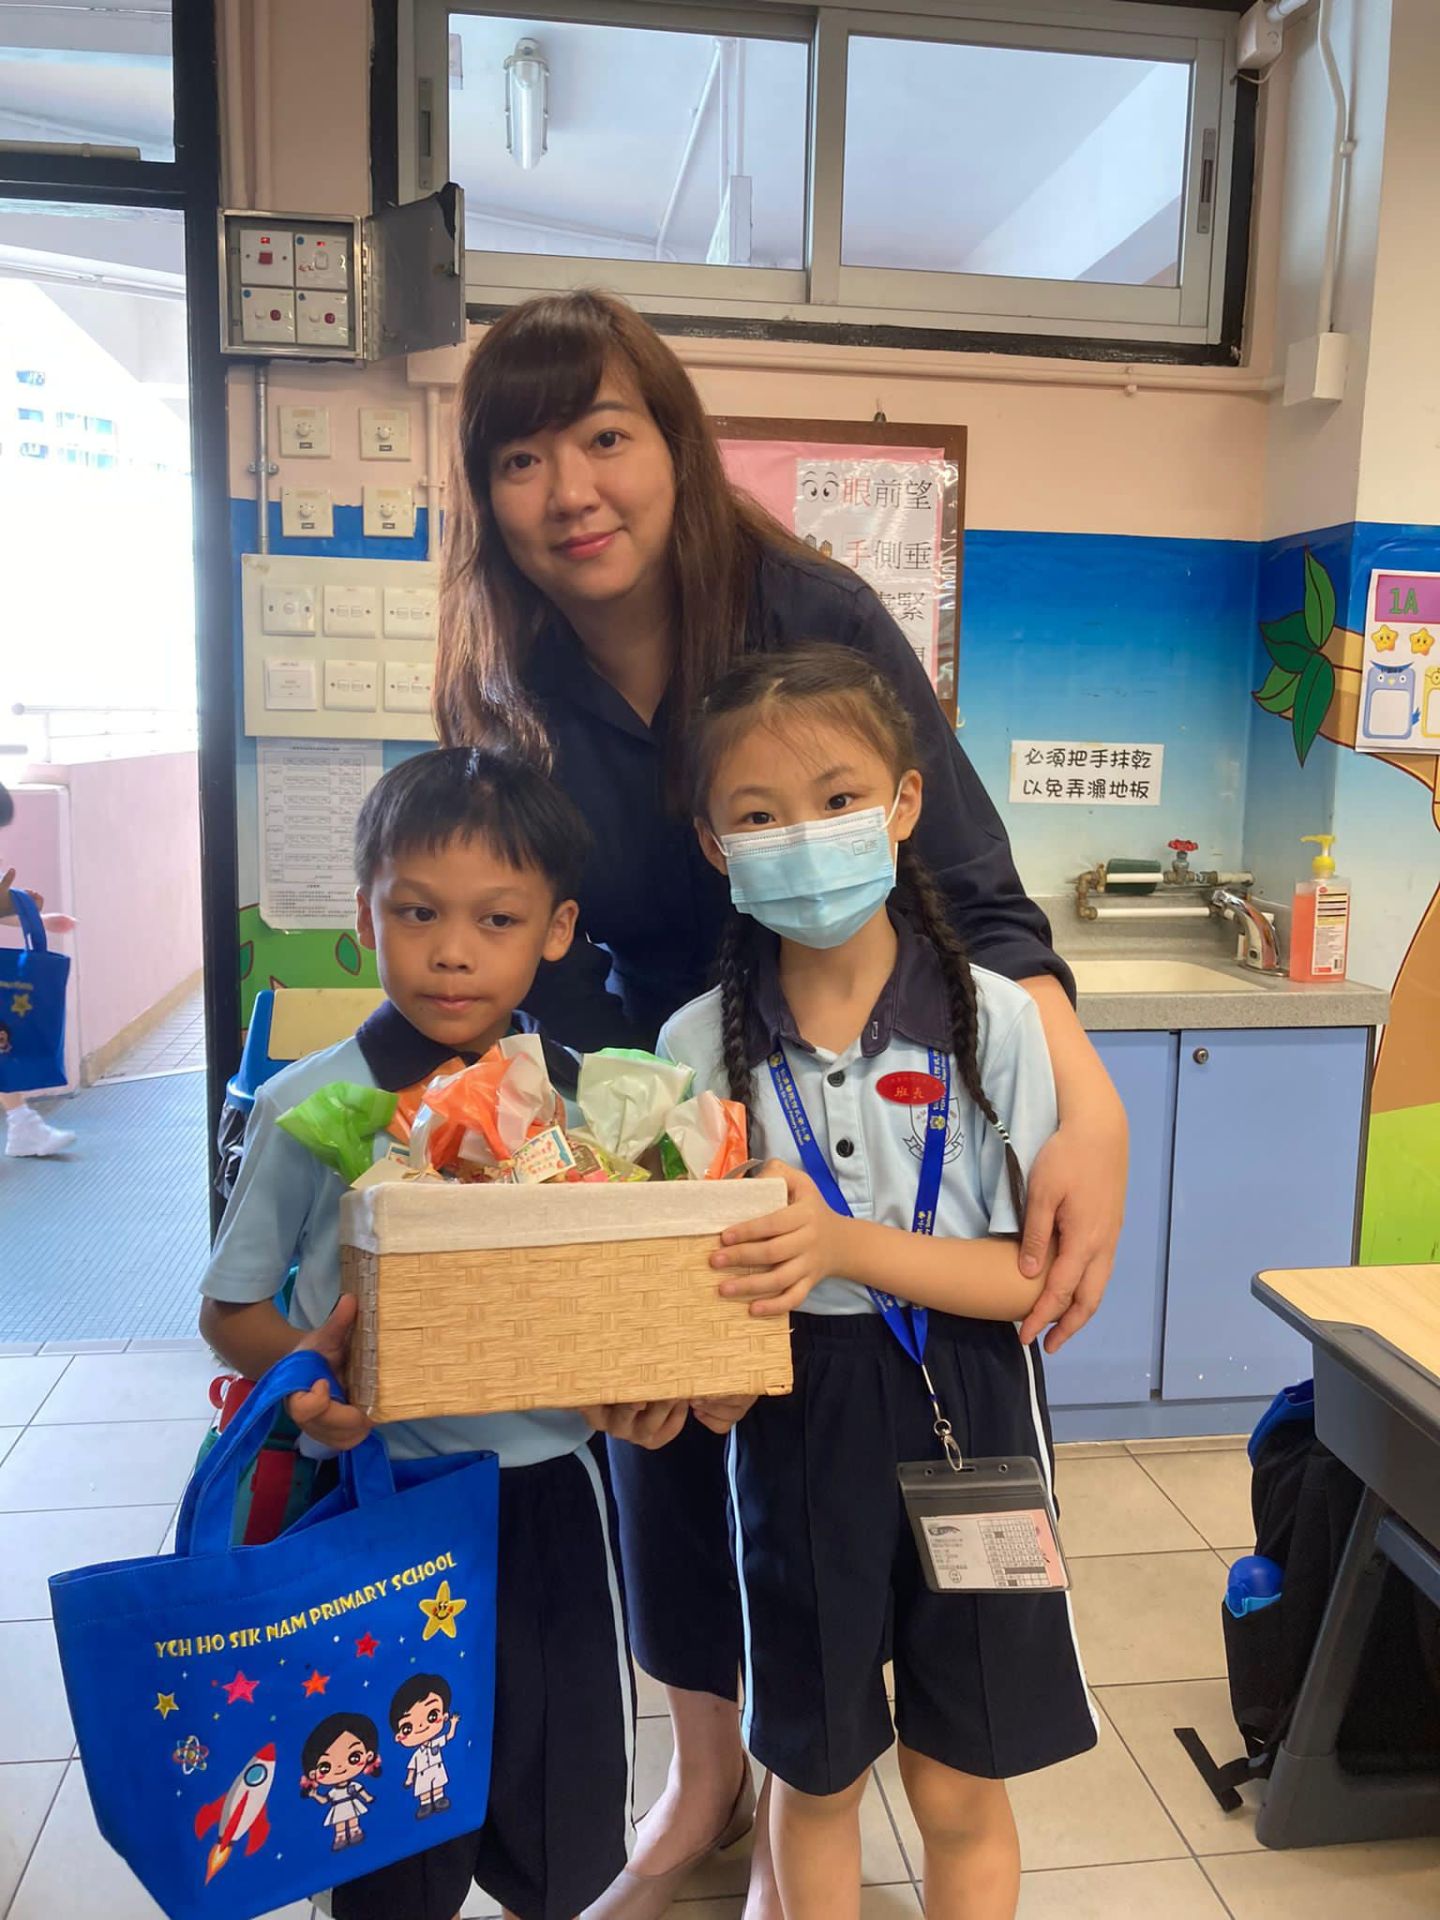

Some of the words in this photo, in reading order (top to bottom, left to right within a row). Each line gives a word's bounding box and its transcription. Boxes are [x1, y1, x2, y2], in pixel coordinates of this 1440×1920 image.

[842, 477, 932, 510] 眼前望
[845, 539, 931, 570] 手側垂
[1389, 587, 1419, 615] 1A
[154, 1638, 191, 1658] YCH
[197, 1634, 225, 1655] HO
[229, 1628, 261, 1649] SIK
[266, 1612, 308, 1642] NAM
[309, 1579, 388, 1626] PRIMARY
[391, 1551, 457, 1591] SCHOOL
